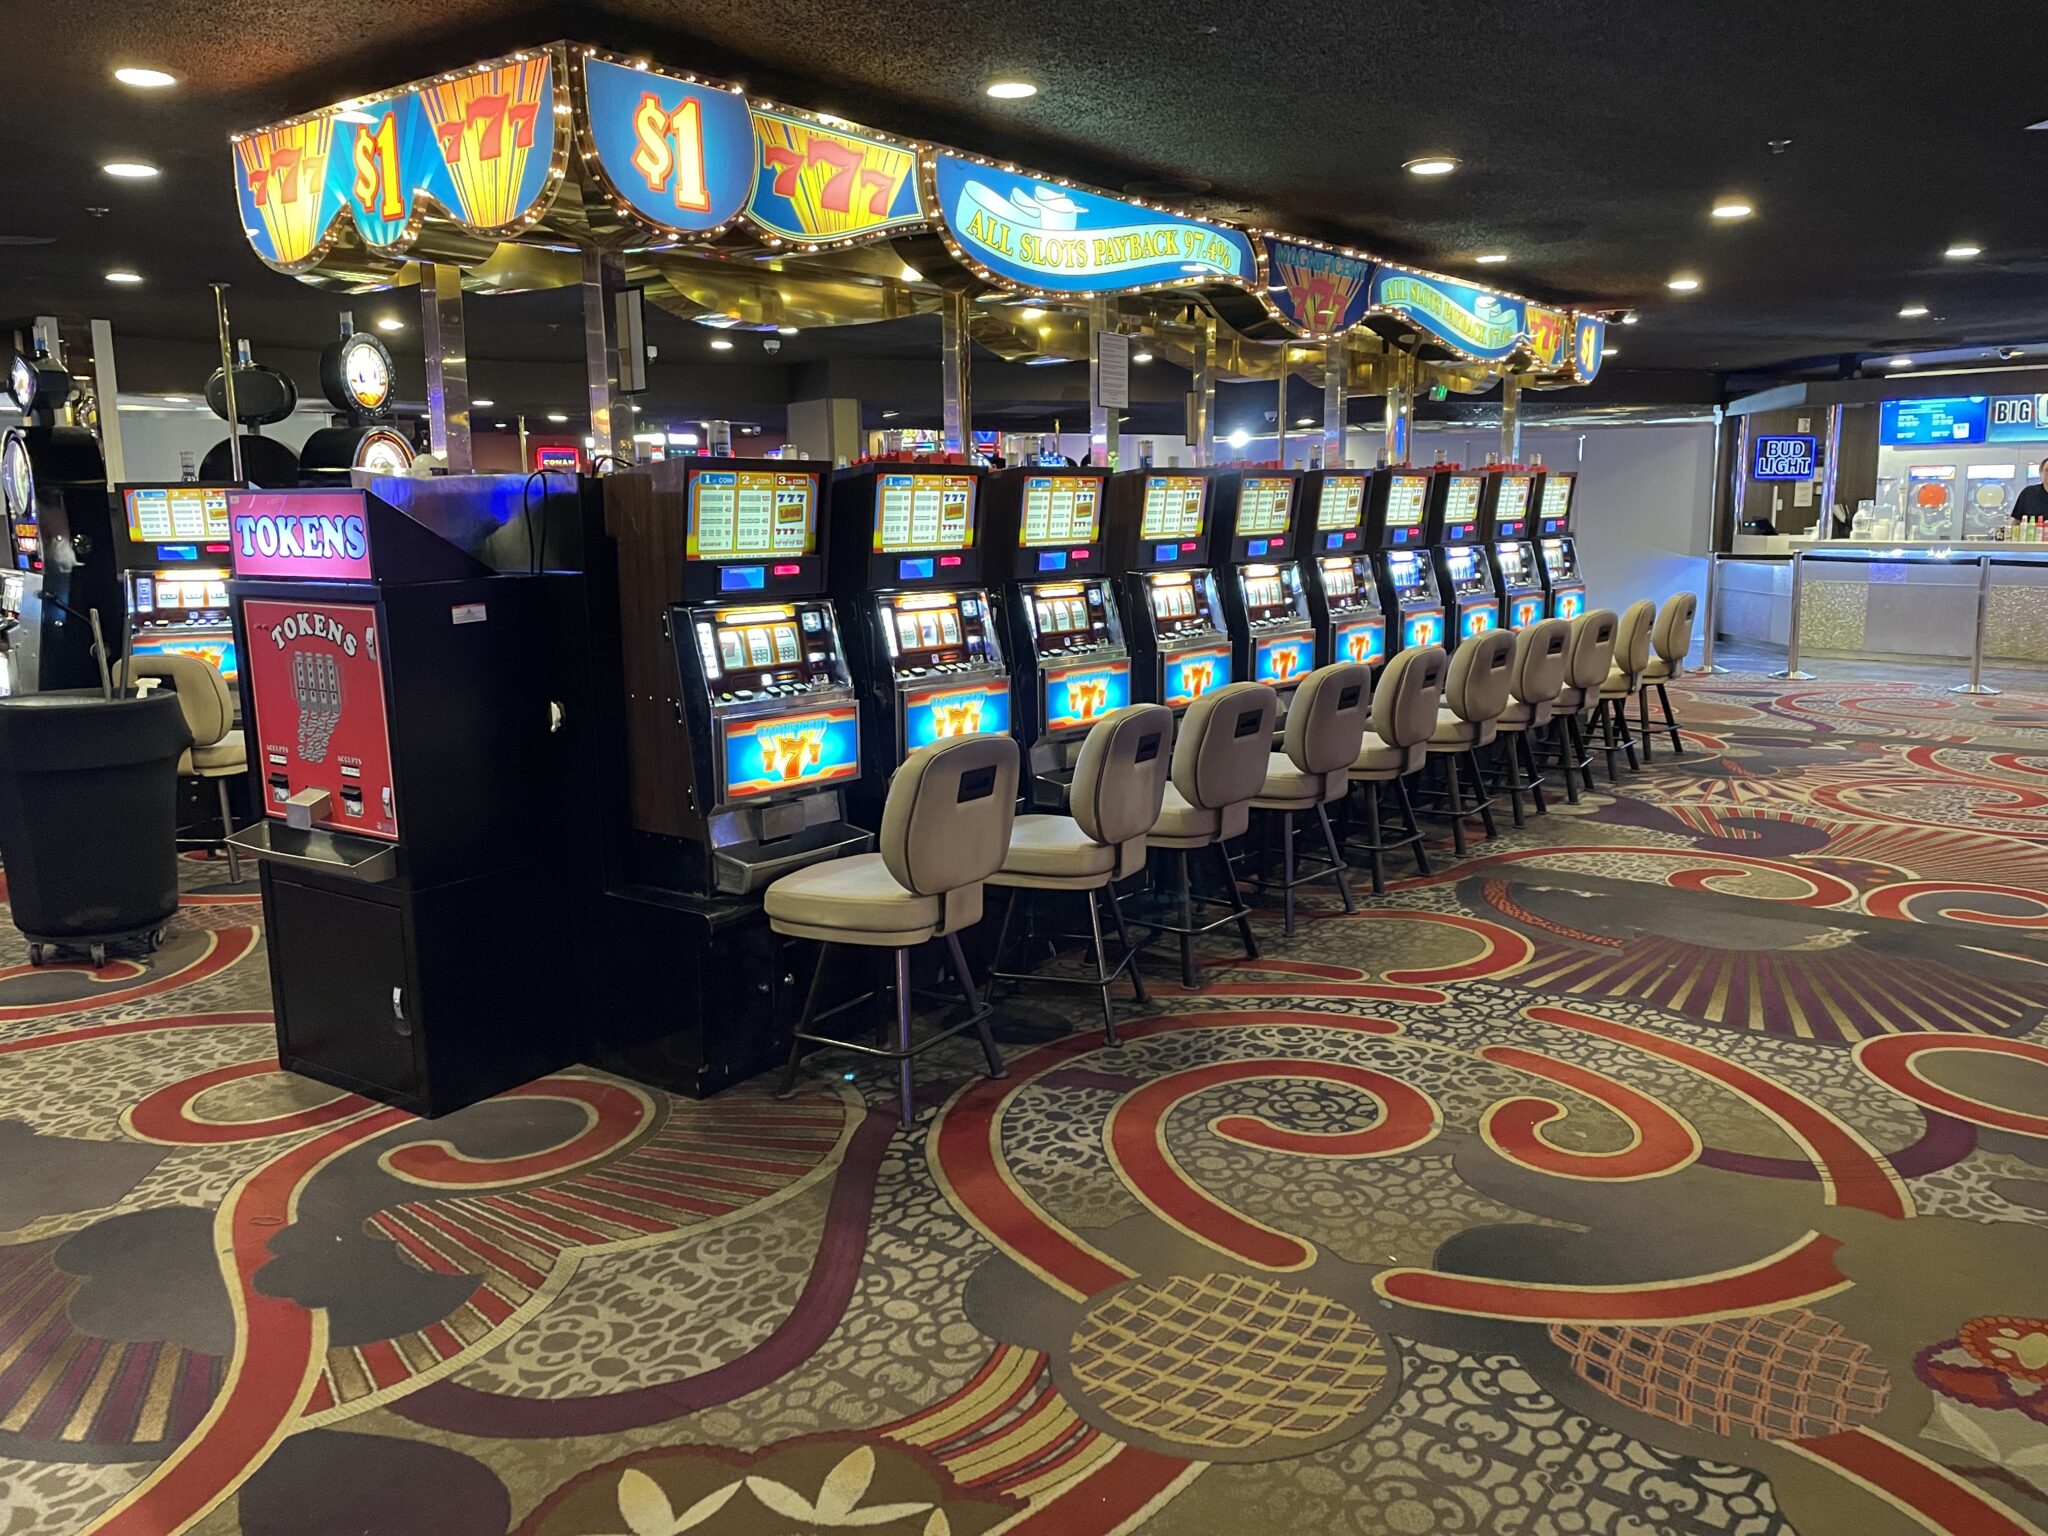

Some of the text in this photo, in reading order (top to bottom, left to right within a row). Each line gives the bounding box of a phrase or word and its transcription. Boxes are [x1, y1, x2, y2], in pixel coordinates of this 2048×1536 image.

[438, 93, 540, 165] 777
[631, 91, 711, 214] $1
[249, 146, 323, 207] 777
[354, 111, 405, 222] $1
[765, 138, 895, 218] 777
[966, 209, 1232, 270] ALL SLOTS PAYBACK 97.4%
[1275, 243, 1368, 280] MAGNIFICENT
[1292, 278, 1348, 325] 777
[1385, 279, 1407, 301] ALL
[1409, 282, 1442, 316] SLOTS
[1444, 301, 1488, 345] PAYBACK
[1581, 325, 1596, 372] $1
[1995, 400, 2032, 424] BIG
[1758, 457, 1811, 474] LIGHT
[1766, 440, 1805, 458] BUD
[235, 515, 366, 559] TOKENS
[271, 612, 358, 657] TOKENS
